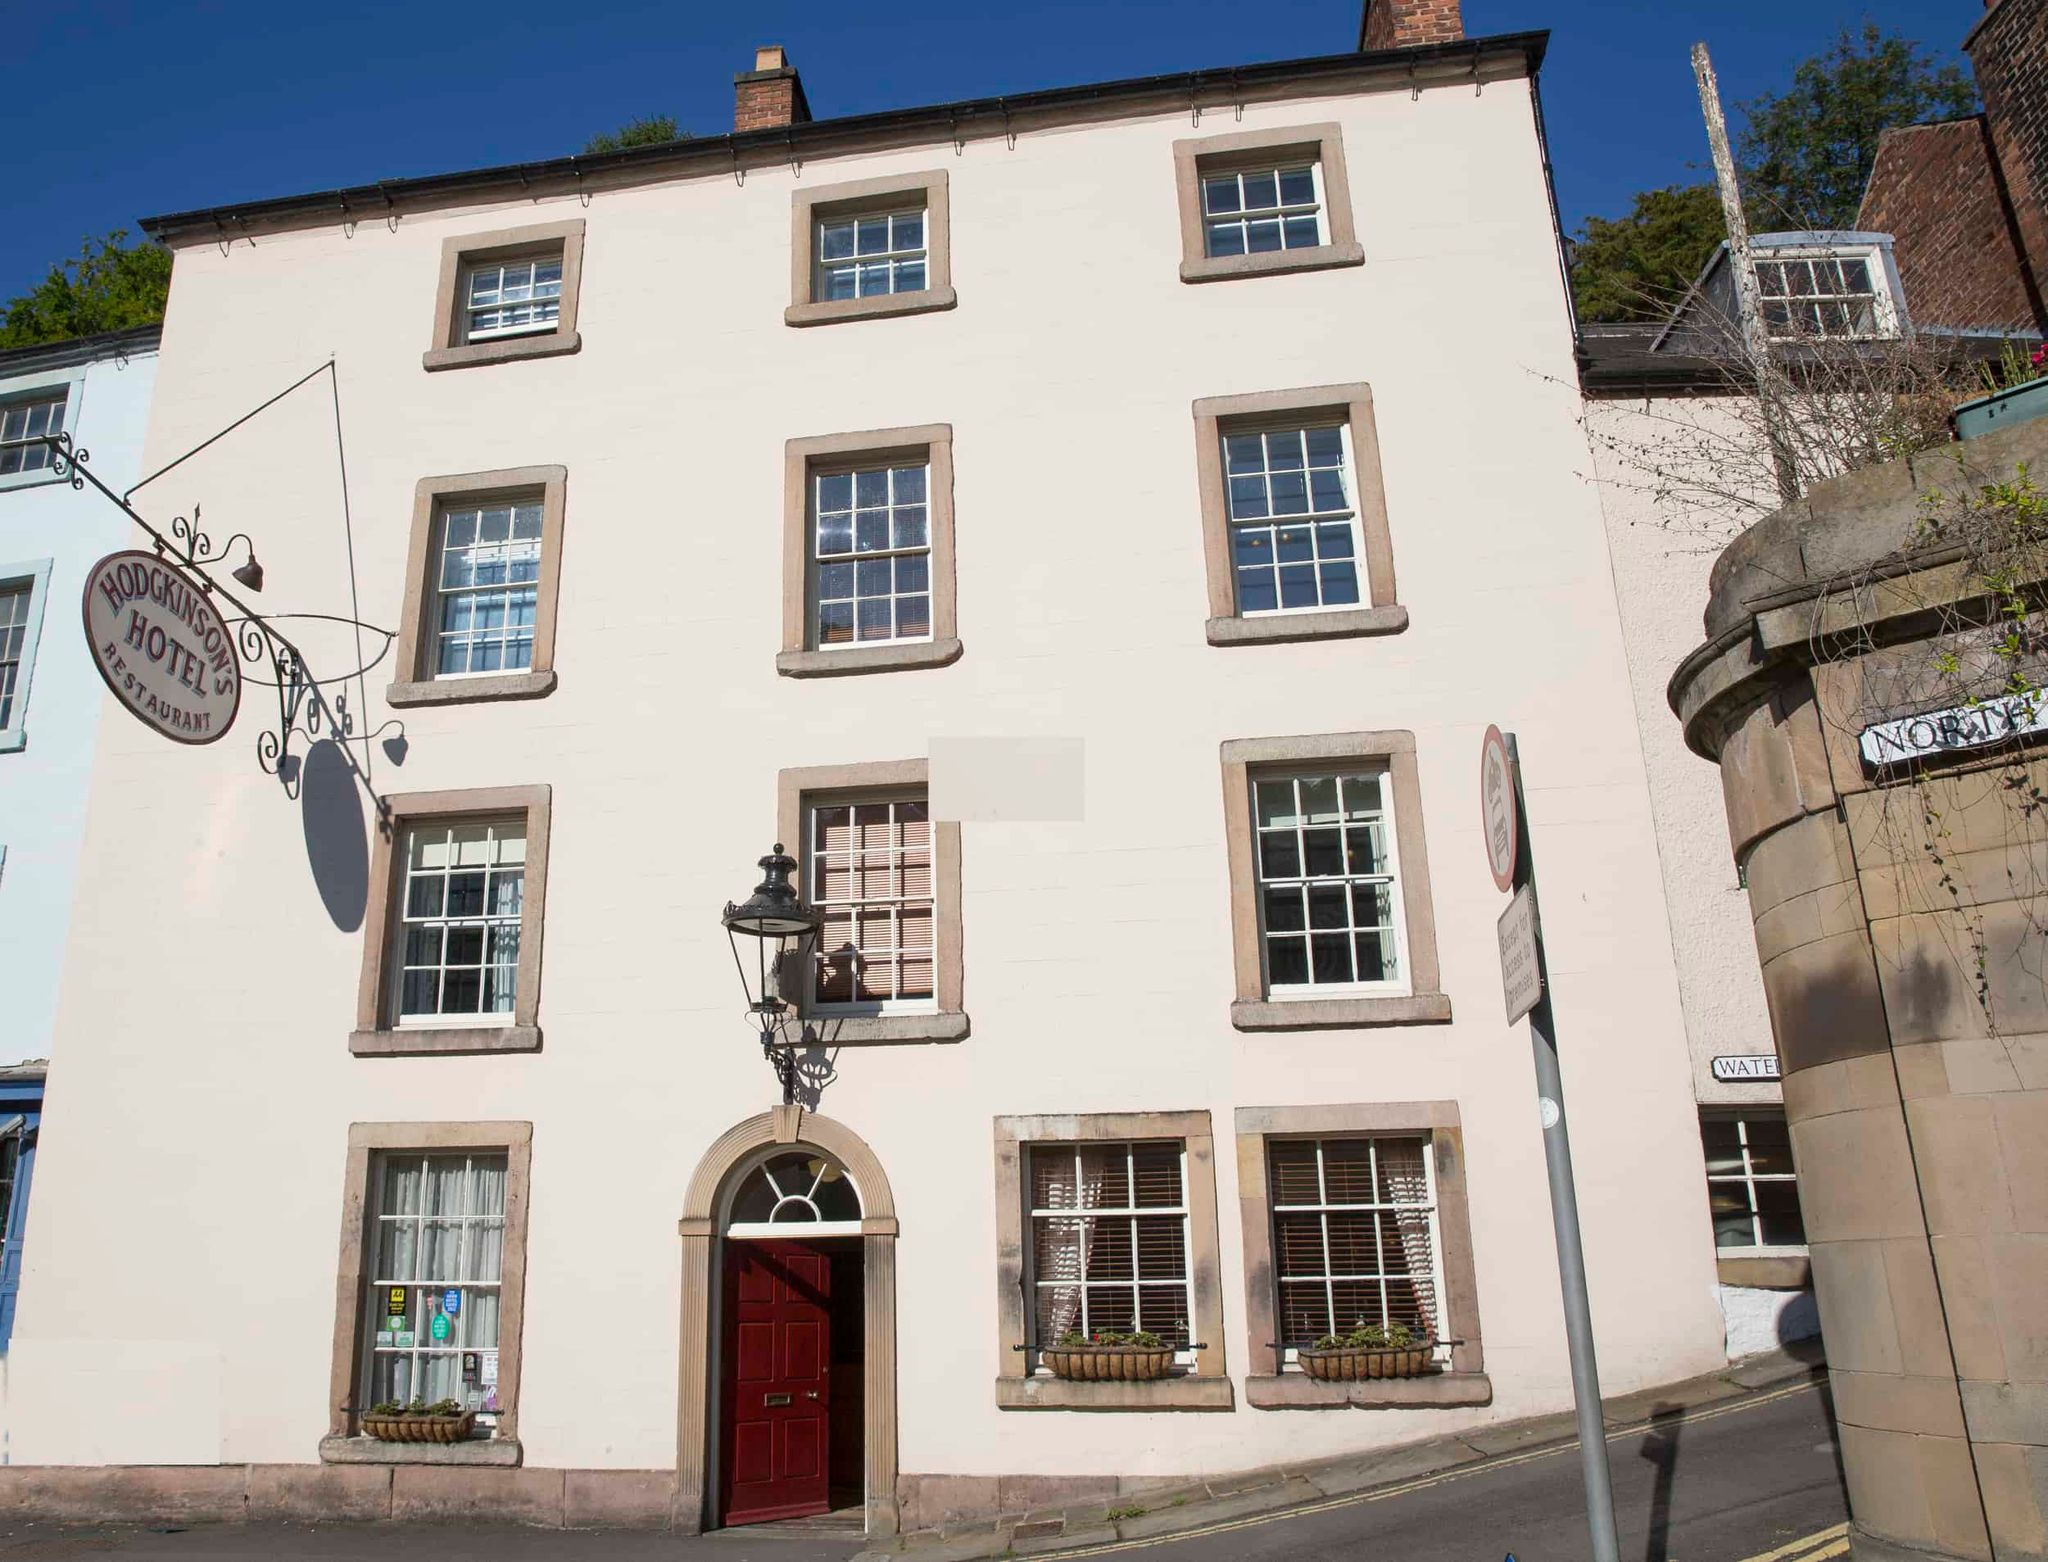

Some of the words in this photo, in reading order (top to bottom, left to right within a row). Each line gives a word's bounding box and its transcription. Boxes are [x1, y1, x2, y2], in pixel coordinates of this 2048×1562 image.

[99, 562, 233, 696] HODGKINSON'S
[125, 608, 208, 697] HOTEL
[103, 642, 212, 732] RESTAURANT
[1871, 697, 2038, 758] NORTH
[1719, 1059, 1780, 1075] WATE
